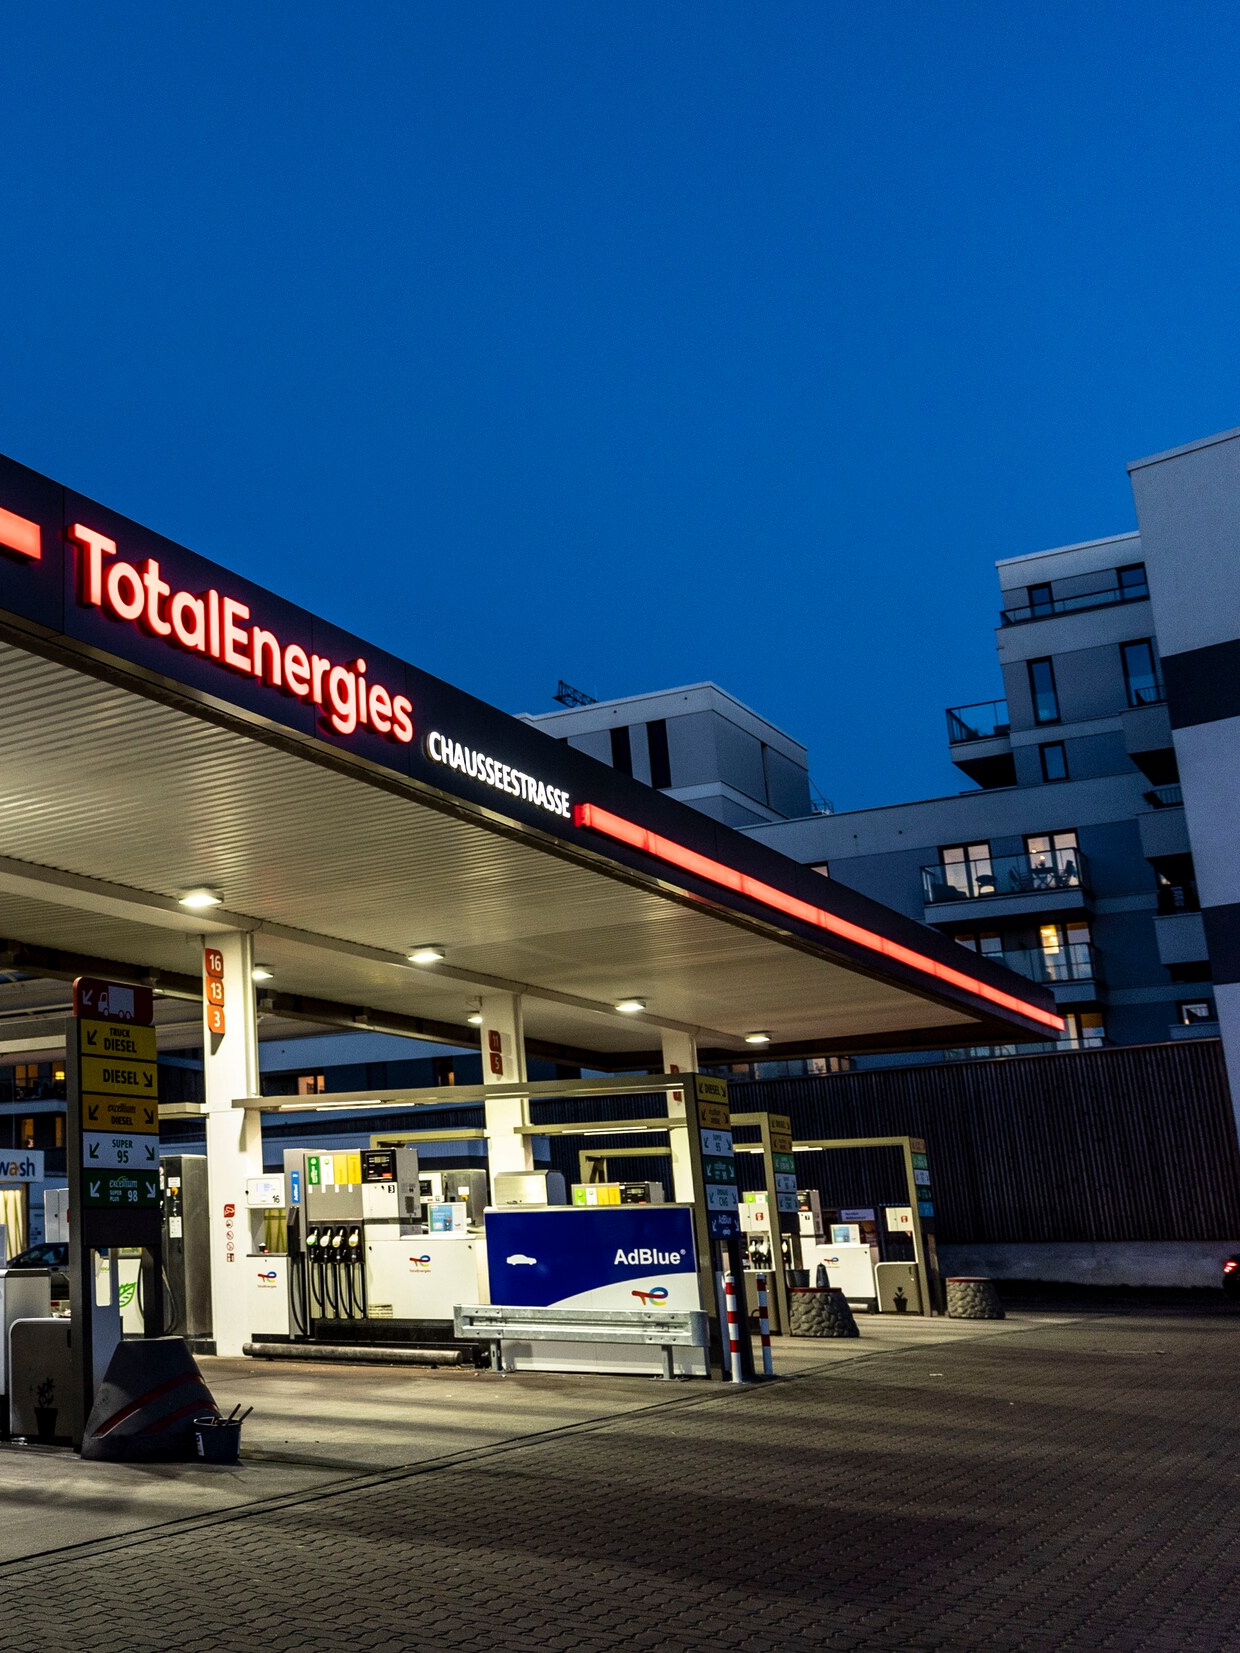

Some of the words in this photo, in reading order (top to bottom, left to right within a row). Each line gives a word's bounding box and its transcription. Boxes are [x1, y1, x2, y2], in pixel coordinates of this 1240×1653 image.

[69, 522, 413, 743] TotalEnergies
[428, 731, 571, 819] CHAUSSEESTRASSE
[209, 954, 222, 972] 16
[211, 982, 222, 999] 13
[213, 1010, 221, 1028] 3
[109, 1027, 130, 1038] TRUCK
[104, 1037, 137, 1053] DIESEL
[102, 1068, 139, 1085] DIESEL
[107, 1103, 136, 1114] excellium
[111, 1115, 133, 1126] DIESEL
[111, 1138, 133, 1149] SUPER
[116, 1150, 129, 1164] 95
[127, 1190, 139, 1202] 98
[272, 1194, 280, 1204] 16
